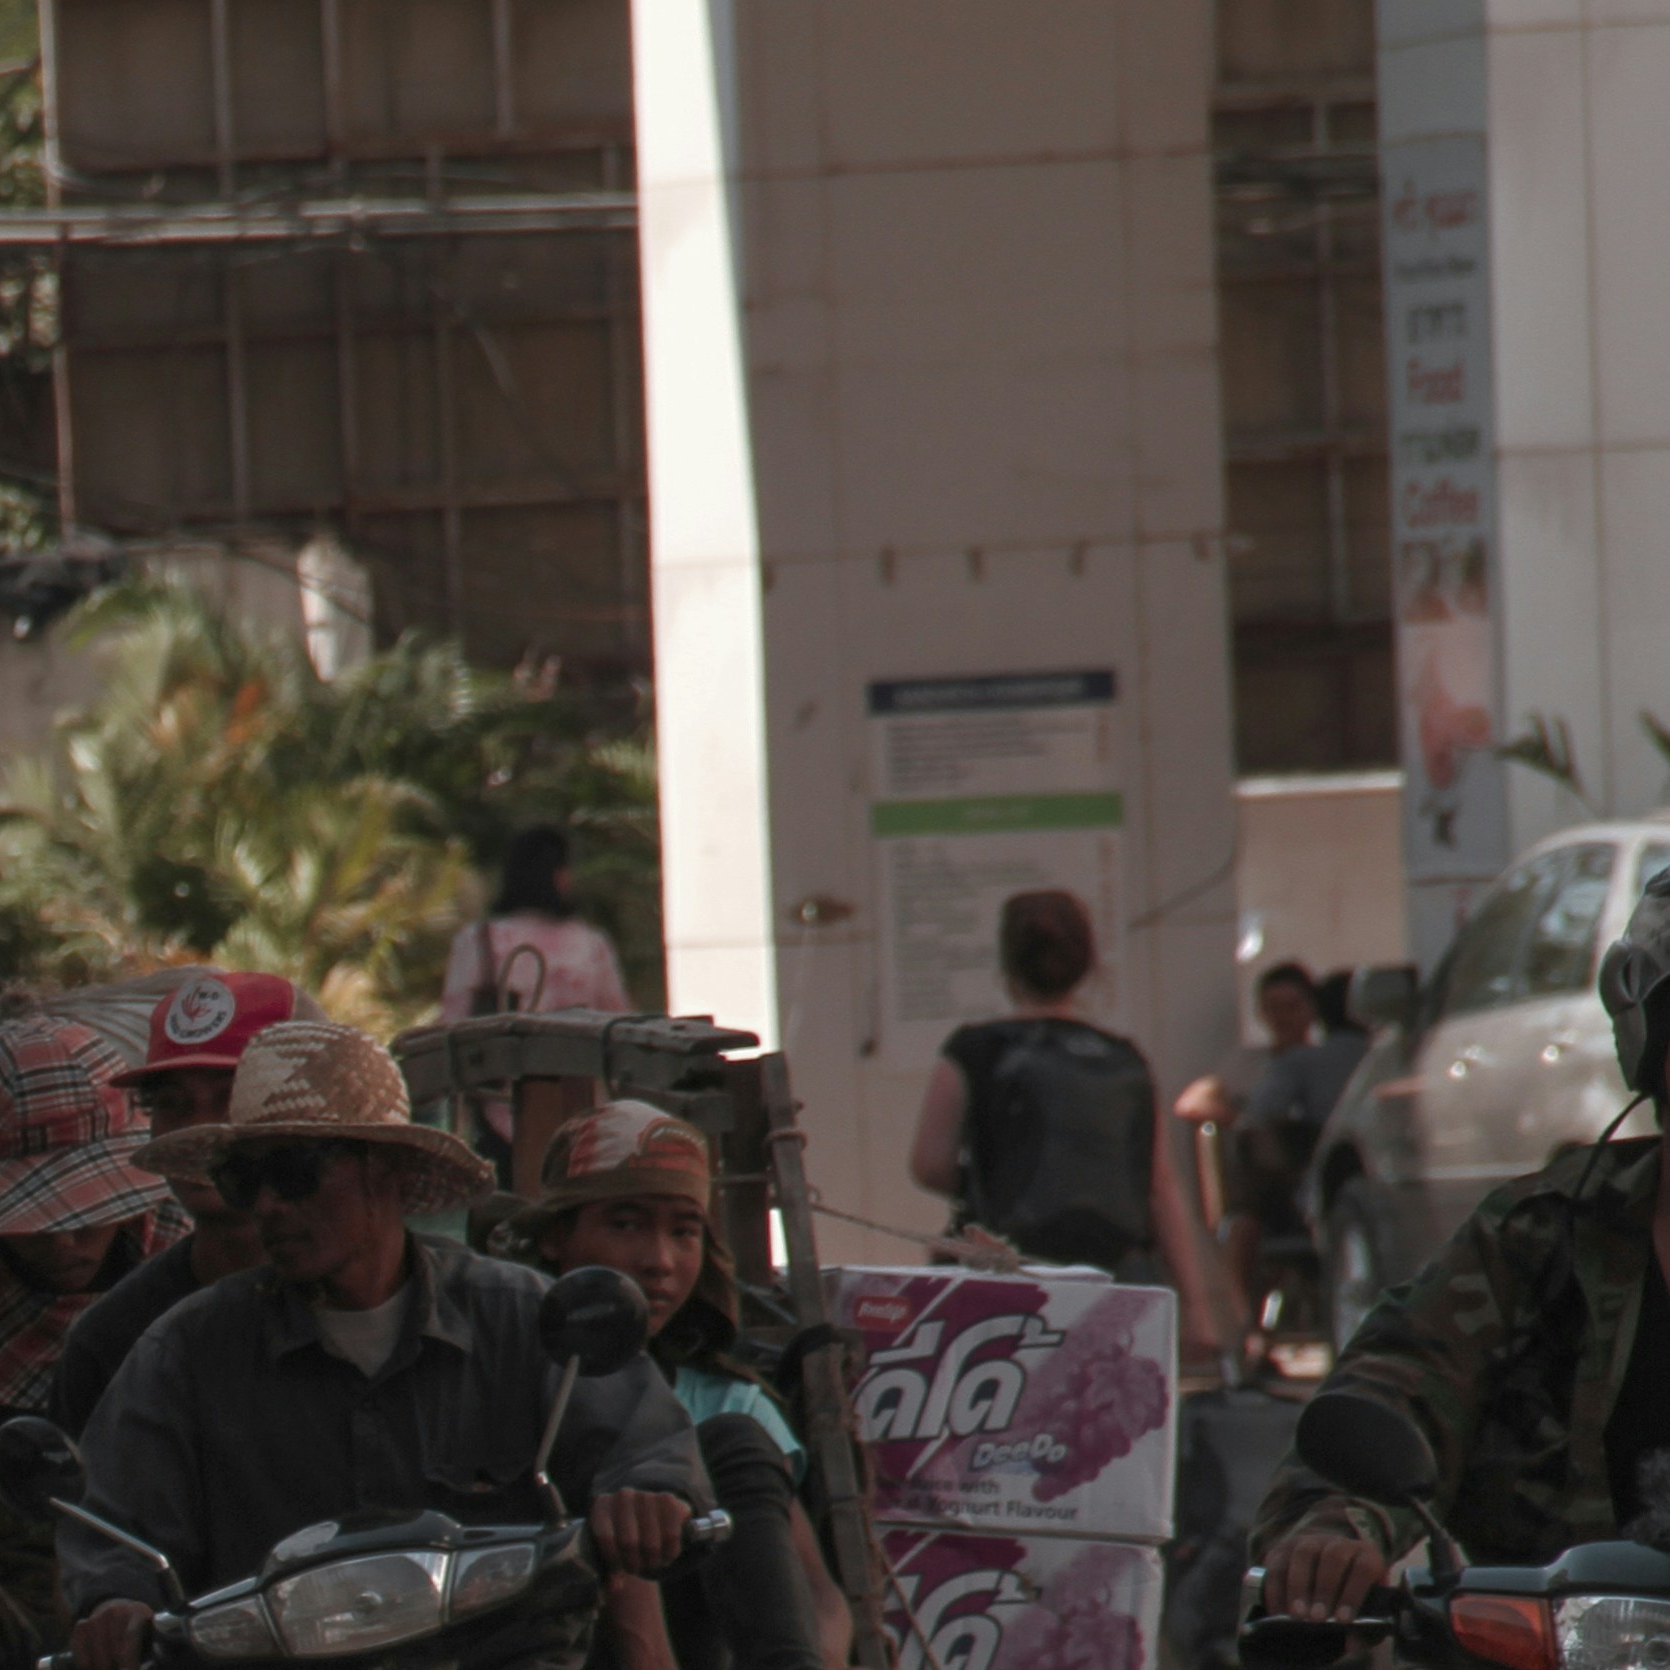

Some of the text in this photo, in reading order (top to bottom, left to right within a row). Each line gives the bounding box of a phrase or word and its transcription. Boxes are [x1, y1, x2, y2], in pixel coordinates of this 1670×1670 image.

[1402, 480, 1480, 530] Coffee
[970, 1433, 1068, 1468] DeeDo
[960, 1479, 1000, 1494] with
[1006, 1500, 1078, 1520] Flavour
